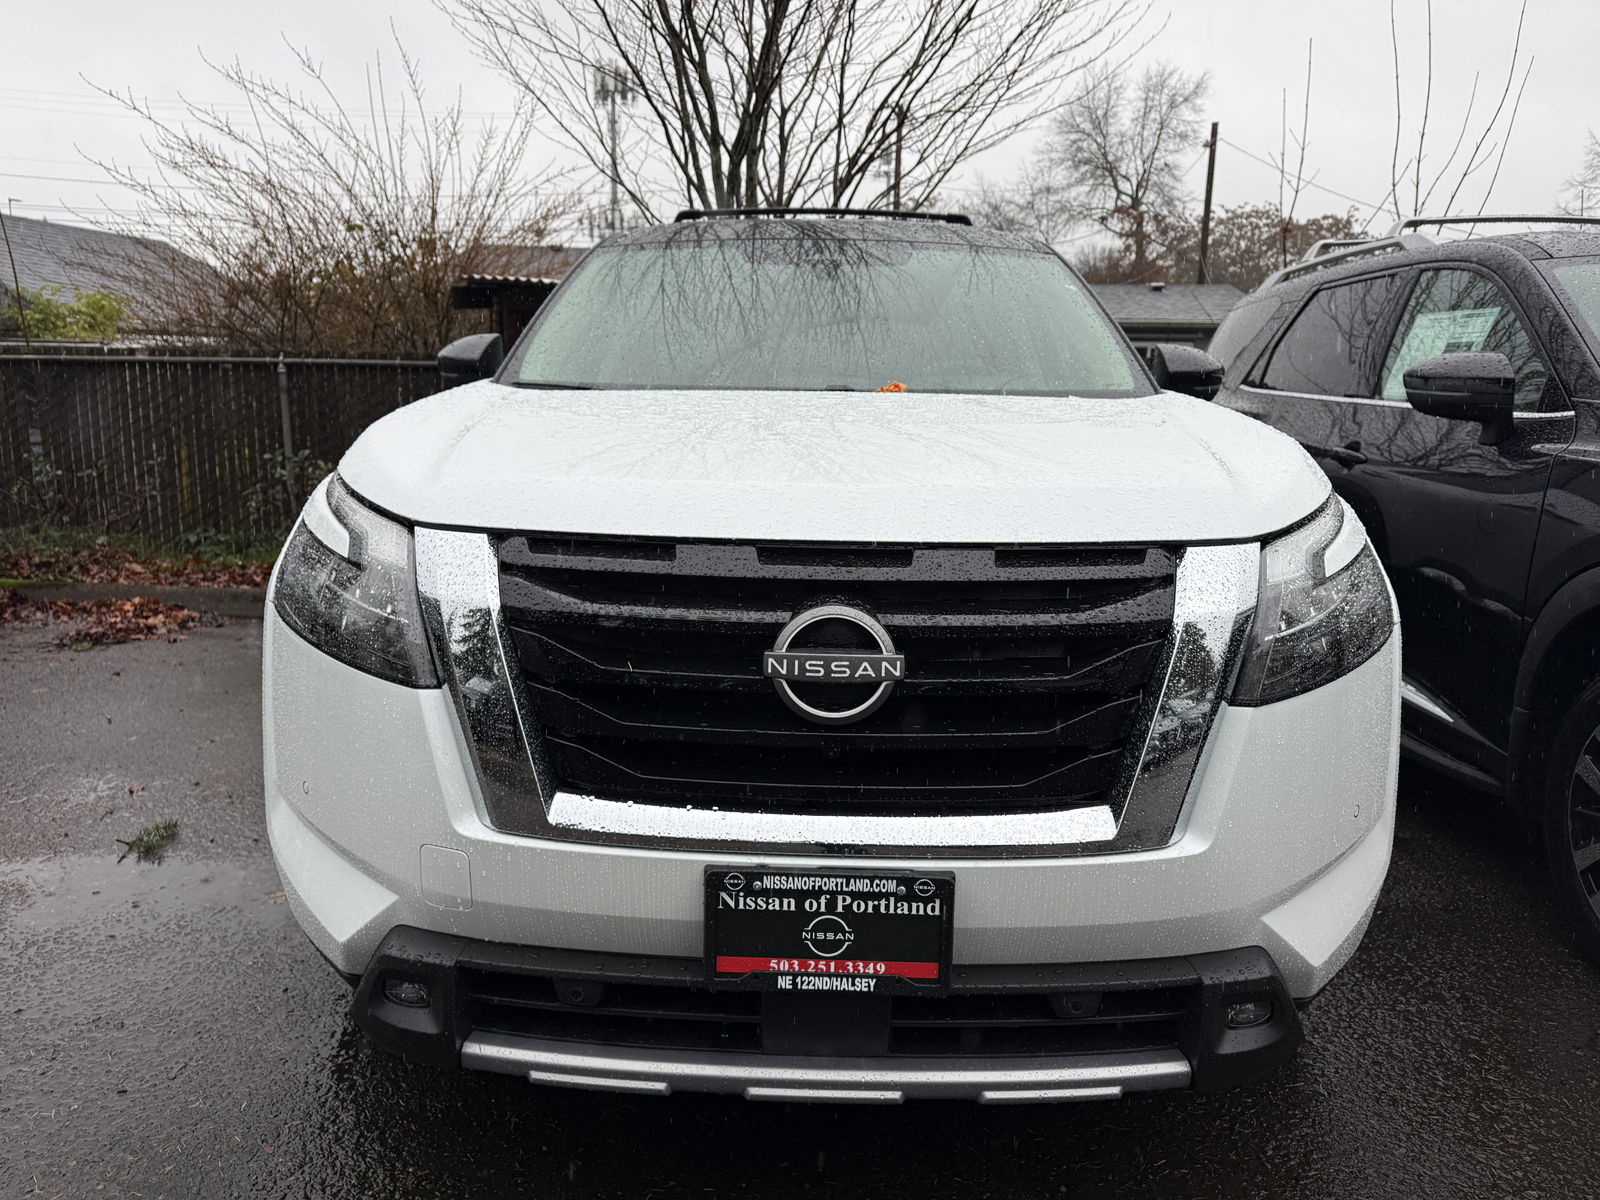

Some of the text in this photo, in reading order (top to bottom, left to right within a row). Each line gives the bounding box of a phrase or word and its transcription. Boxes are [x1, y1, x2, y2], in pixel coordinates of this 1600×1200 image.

[767, 657, 901, 678] NISSAN
[763, 875, 897, 893] NISSANOFPORTLAND.COM
[717, 891, 941, 916] Nissan of Portland
[802, 931, 854, 941] NISSAN
[769, 959, 886, 975] 503.251.3349
[777, 975, 877, 992] NE 122ND/HALSEY
